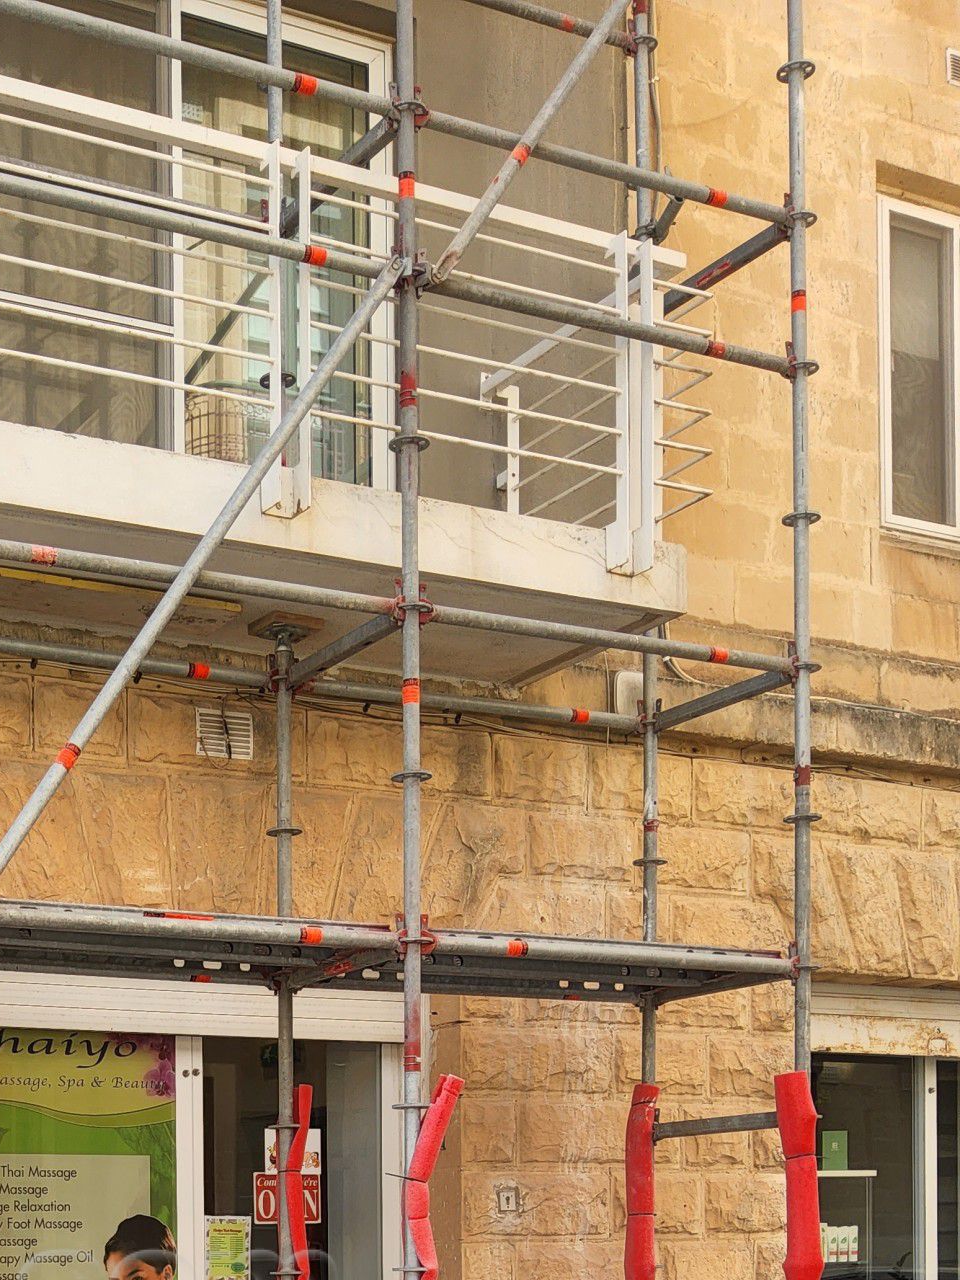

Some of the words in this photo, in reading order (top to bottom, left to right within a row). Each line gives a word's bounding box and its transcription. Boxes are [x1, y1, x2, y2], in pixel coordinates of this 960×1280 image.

[58, 1075, 85, 1093] Spa
[91, 1077, 107, 1088] &
[112, 1079, 168, 1094] Beauty
[1, 1165, 24, 1179] Thai
[28, 1166, 78, 1181] Massage
[257, 1176, 277, 1187] Com
[303, 1176, 318, 1187] e're
[13, 1199, 71, 1212] Relaxation
[258, 1189, 318, 1219] ON
[7, 1218, 31, 1230] Foot
[34, 1218, 83, 1233] Massage
[24, 1252, 73, 1267] Massage
[76, 1250, 94, 1264] Oil
